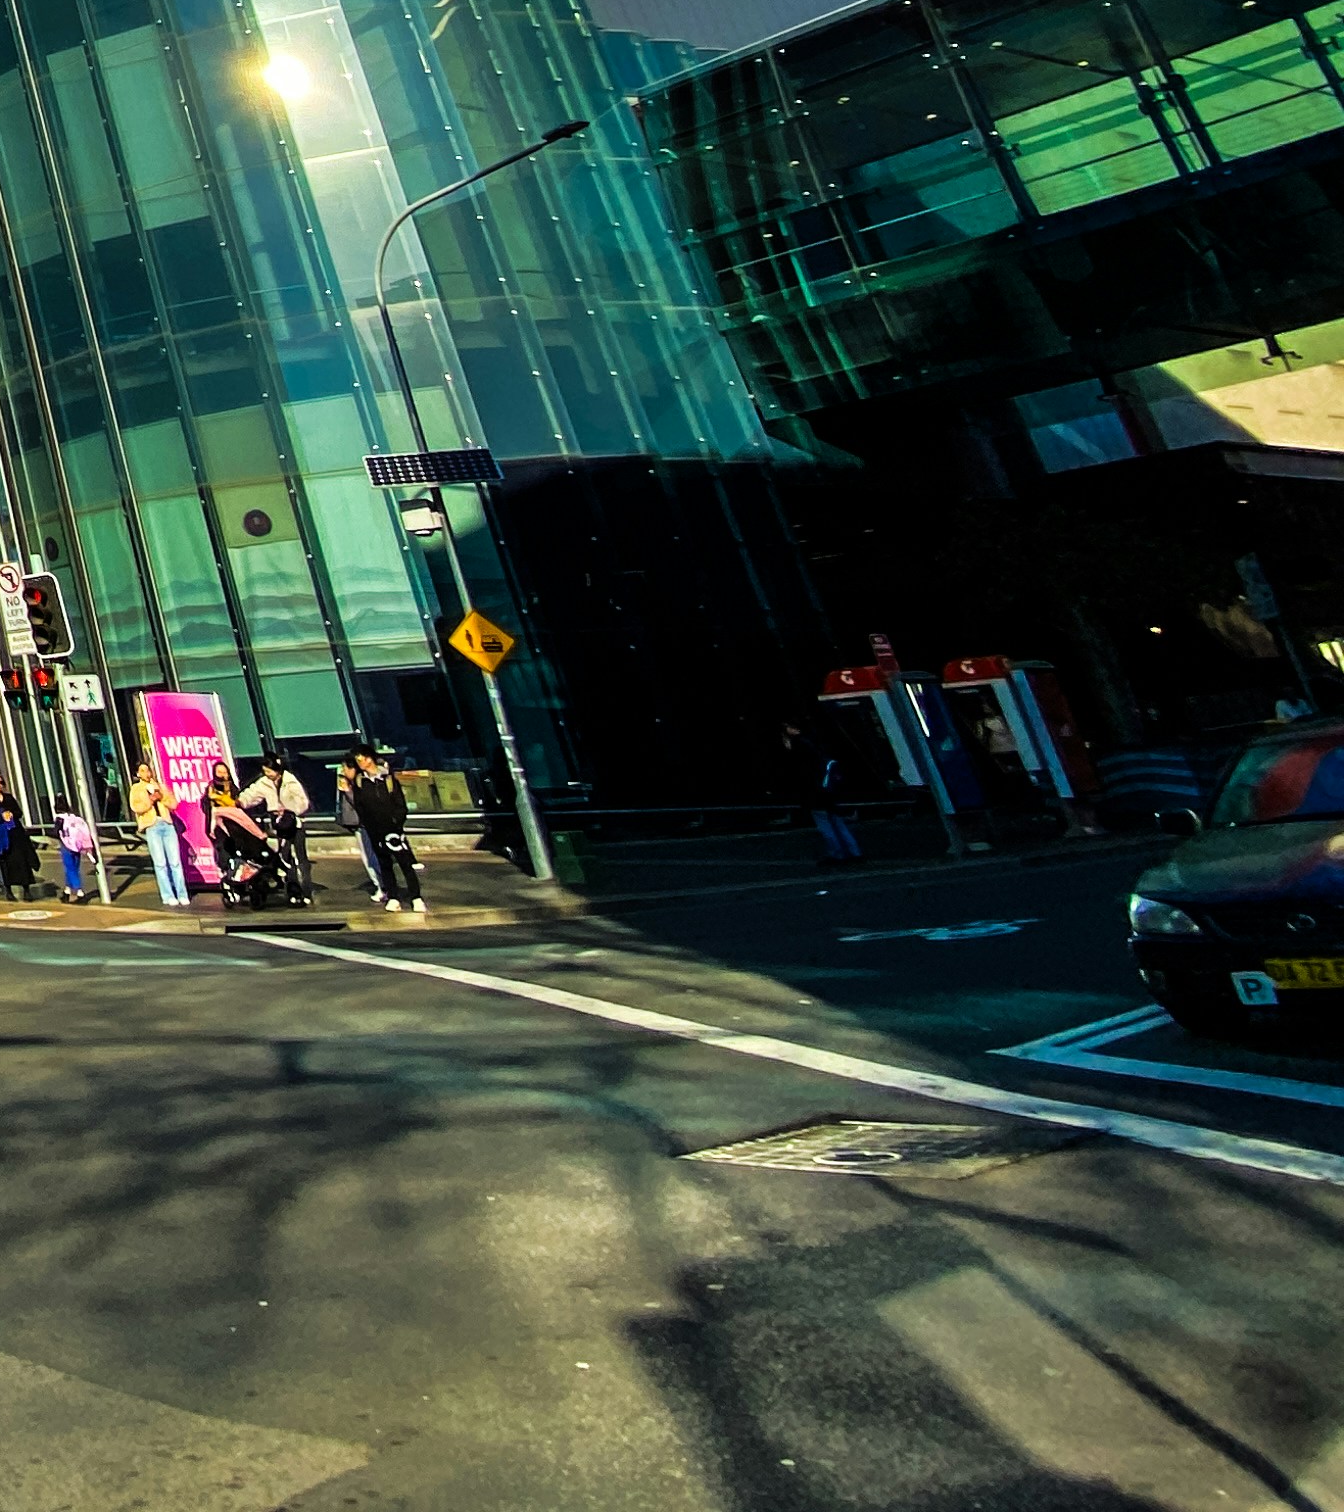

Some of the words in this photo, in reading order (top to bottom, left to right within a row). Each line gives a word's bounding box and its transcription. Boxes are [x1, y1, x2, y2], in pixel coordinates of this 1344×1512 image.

[6, 596, 21, 607] NO
[161, 736, 223, 758] WHERE
[169, 758, 204, 781] ART
[1239, 978, 1263, 1001] P
